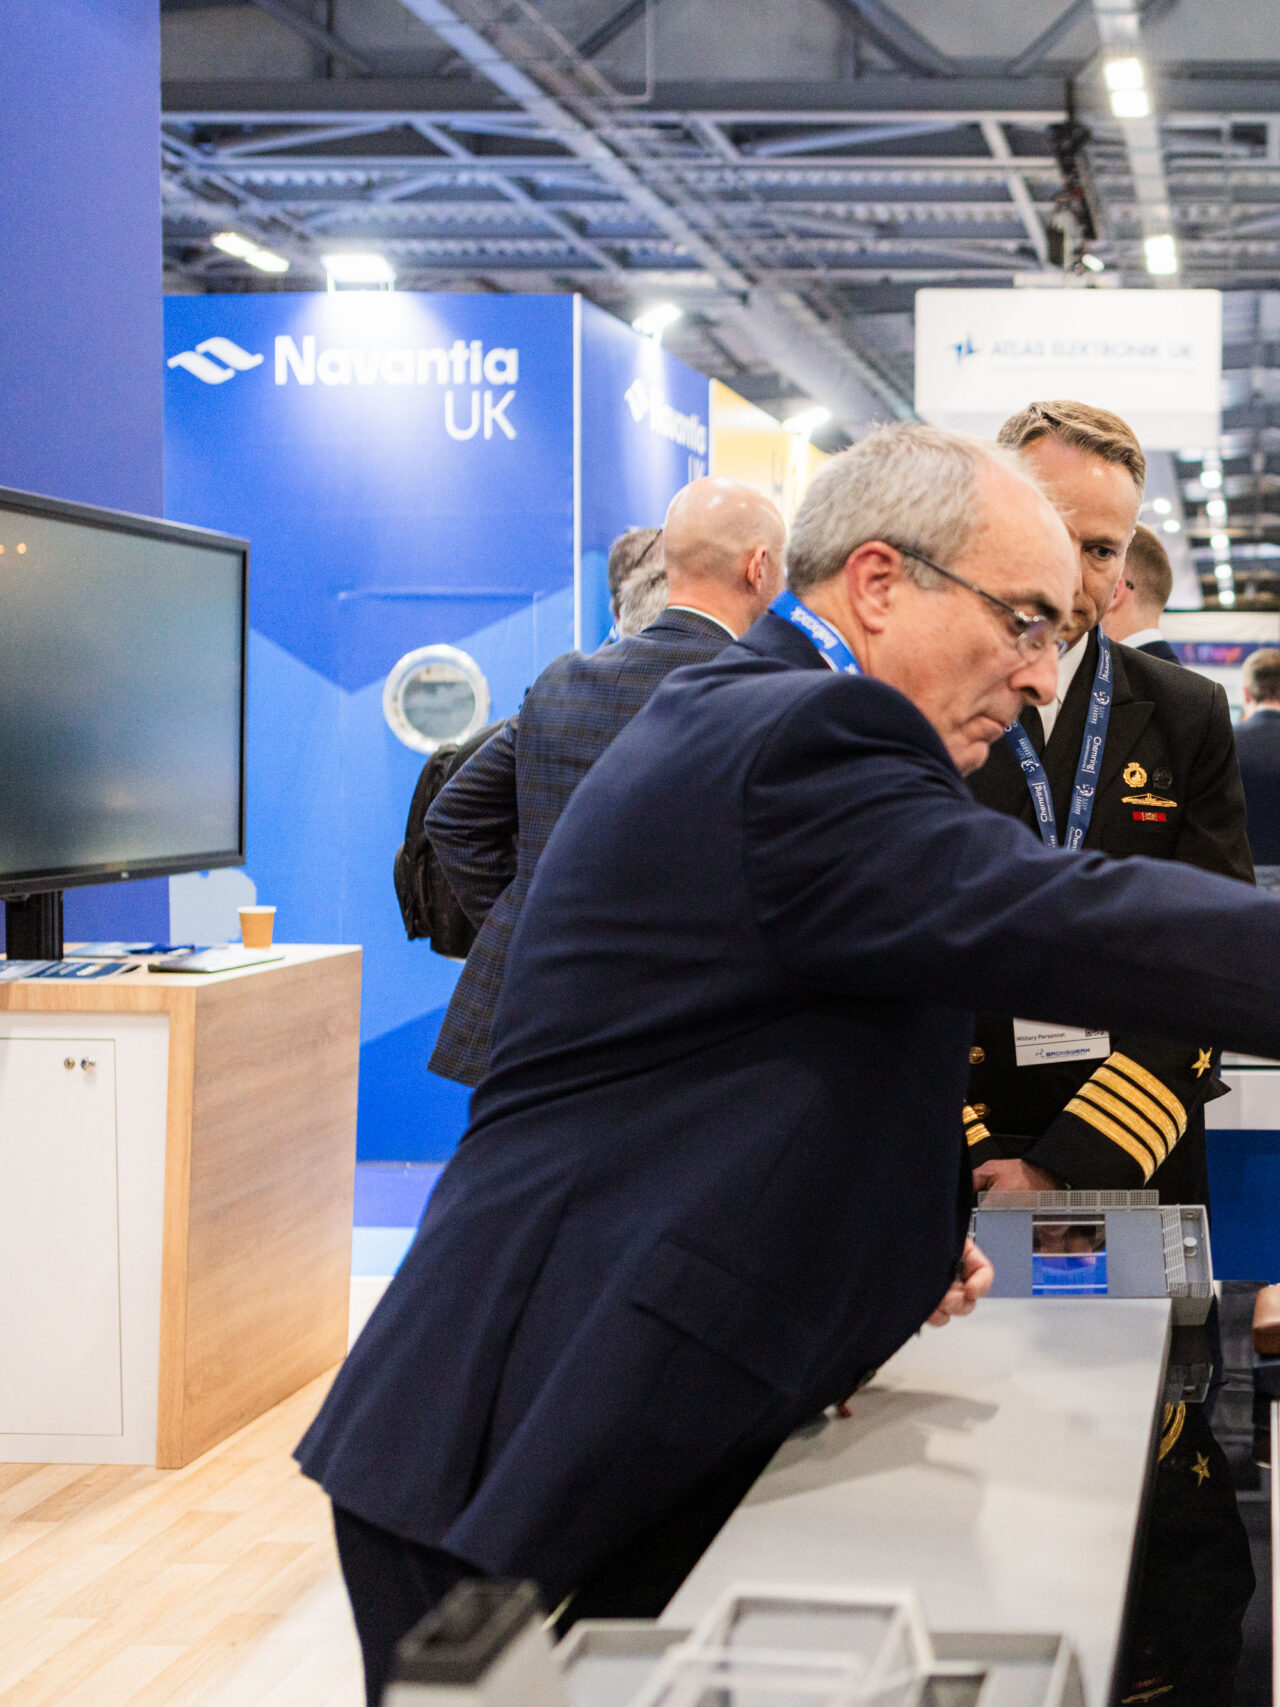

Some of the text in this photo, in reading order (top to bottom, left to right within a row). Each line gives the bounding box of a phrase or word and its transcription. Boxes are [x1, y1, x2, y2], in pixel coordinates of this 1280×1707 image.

[274, 334, 519, 386] Navantia
[444, 389, 517, 441] UK
[1086, 736, 1102, 771] Chemring
[1034, 784, 1048, 823] Chemring
[1037, 1032, 1066, 1040] Personnel
